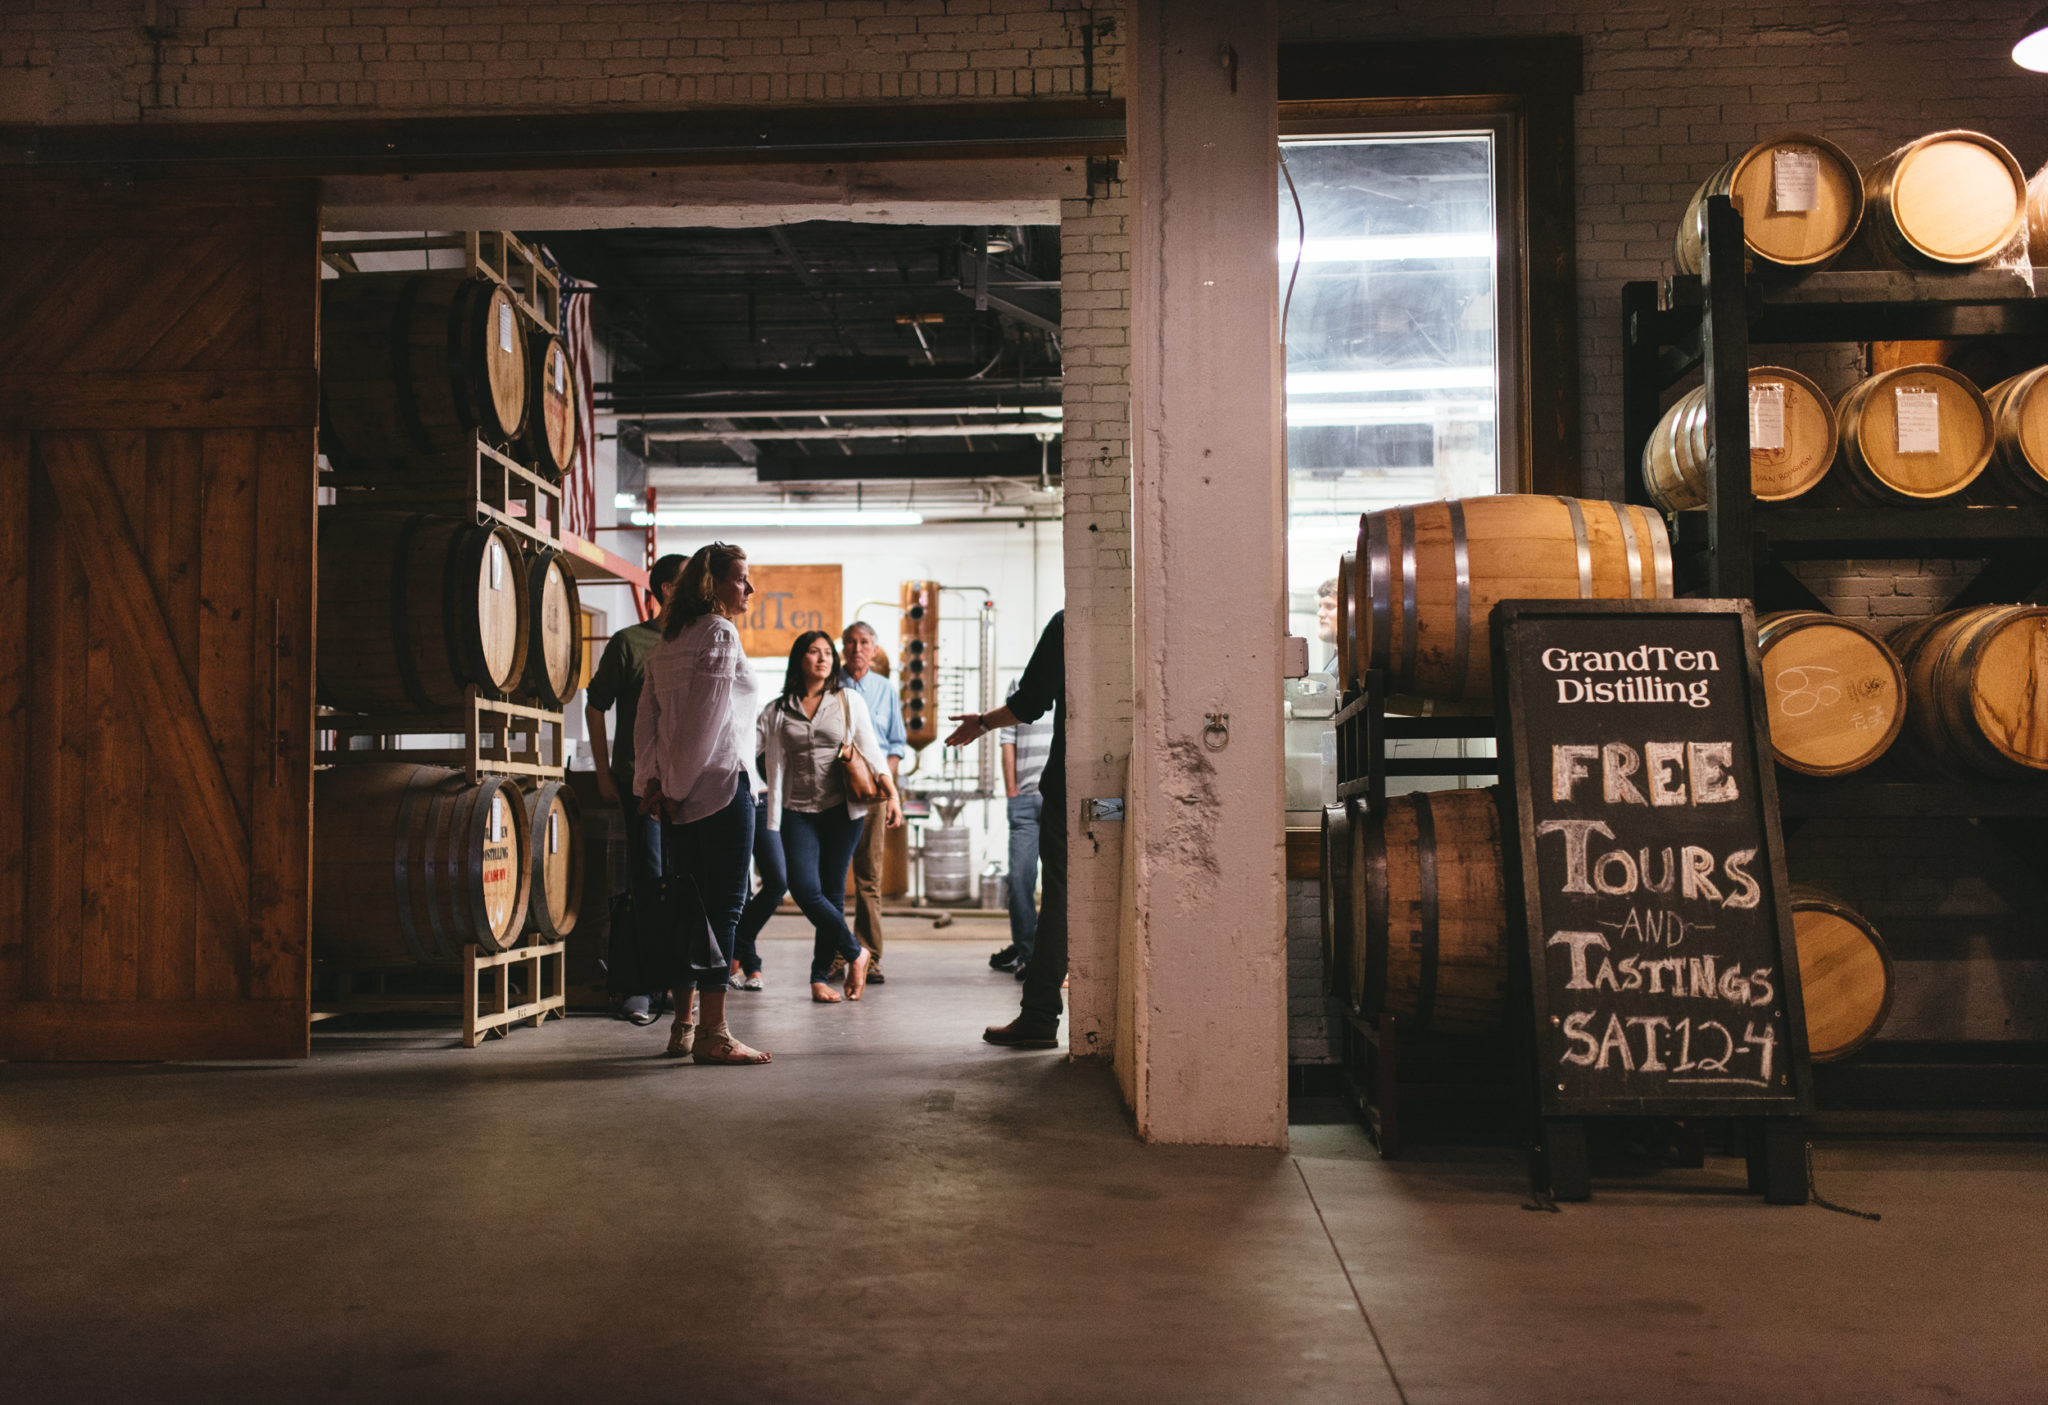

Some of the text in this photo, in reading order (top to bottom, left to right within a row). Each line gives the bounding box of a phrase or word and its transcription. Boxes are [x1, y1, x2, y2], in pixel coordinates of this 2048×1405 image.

[733, 592, 823, 630] ndTen
[1541, 645, 1720, 671] GrandTen
[1556, 676, 1711, 708] Distilling
[1552, 741, 1739, 807] FREE
[1536, 819, 1761, 909] TOURS
[1621, 906, 1684, 948] AND
[1546, 929, 1774, 1007] TASTINGS
